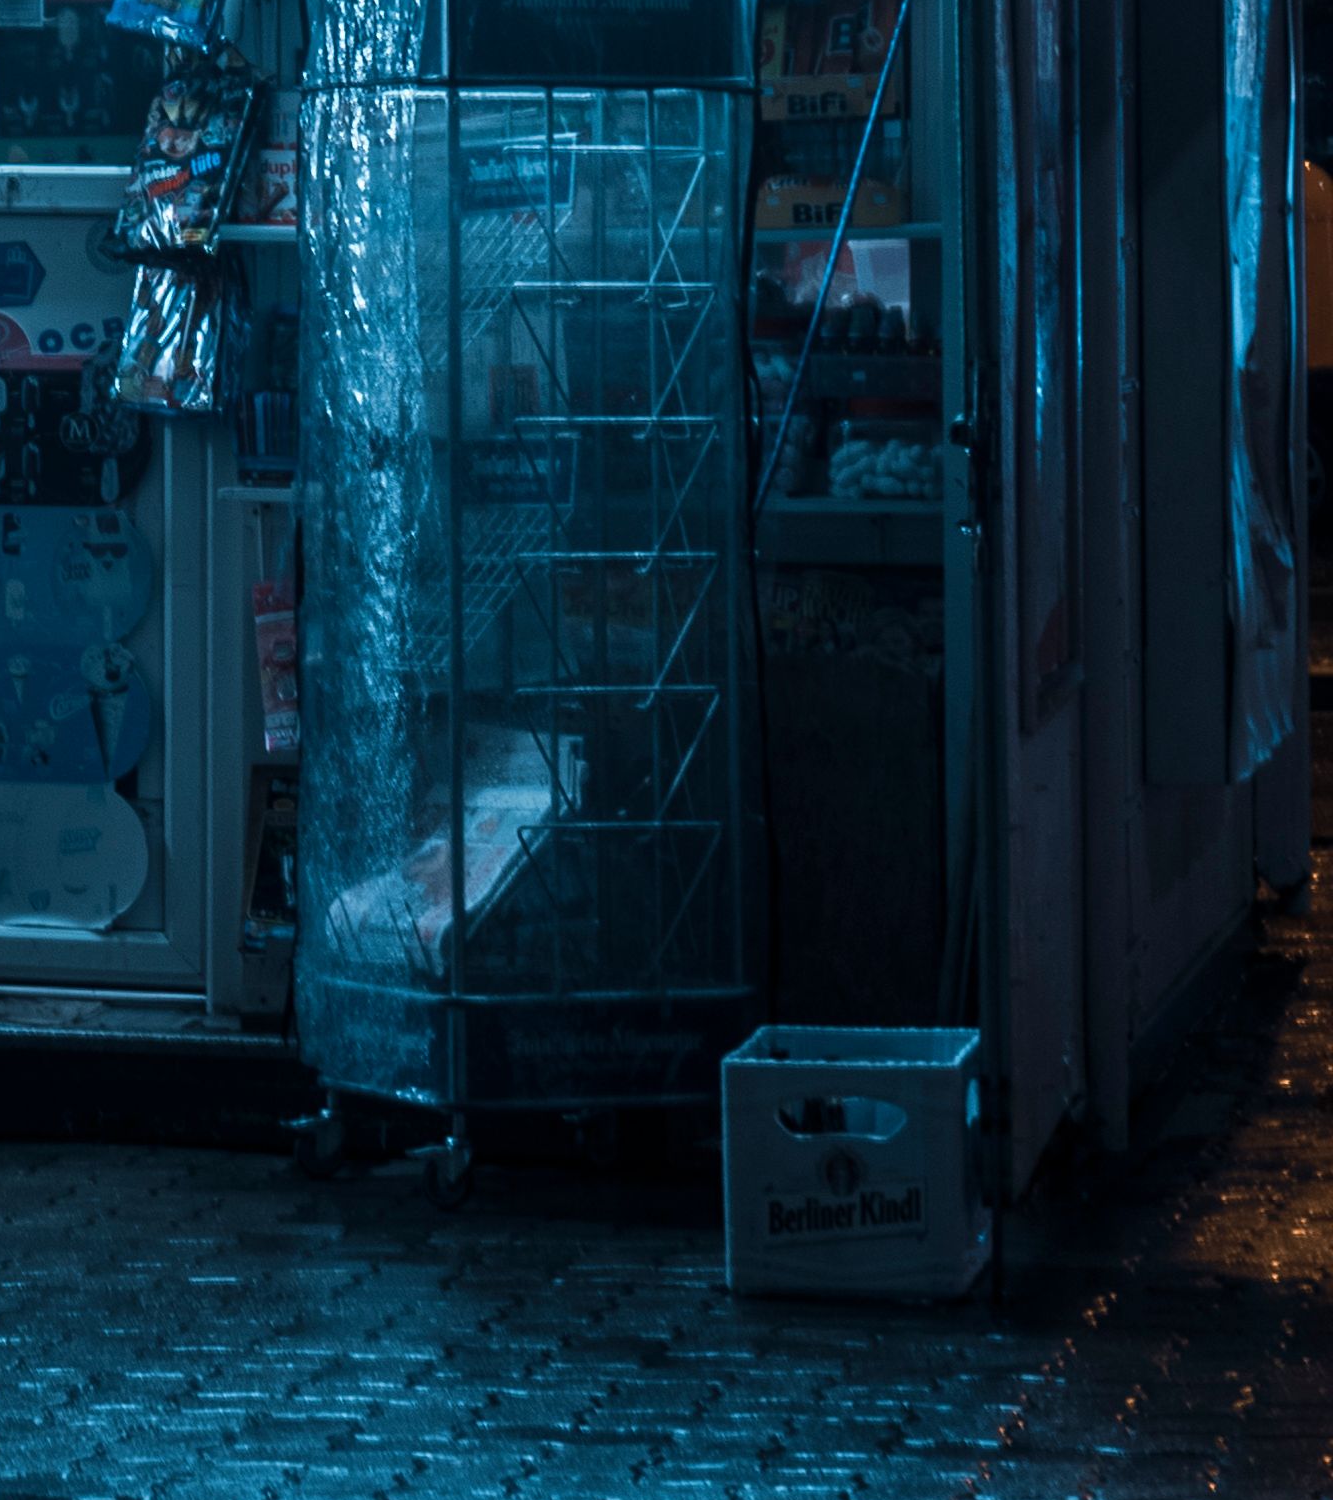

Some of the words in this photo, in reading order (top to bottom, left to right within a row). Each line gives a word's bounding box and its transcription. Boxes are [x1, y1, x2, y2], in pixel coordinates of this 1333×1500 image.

[788, 92, 846, 115] BiFi
[793, 203, 851, 223] BiF
[768, 1198, 857, 1235] Berliner
[860, 1187, 922, 1226] Kindl
